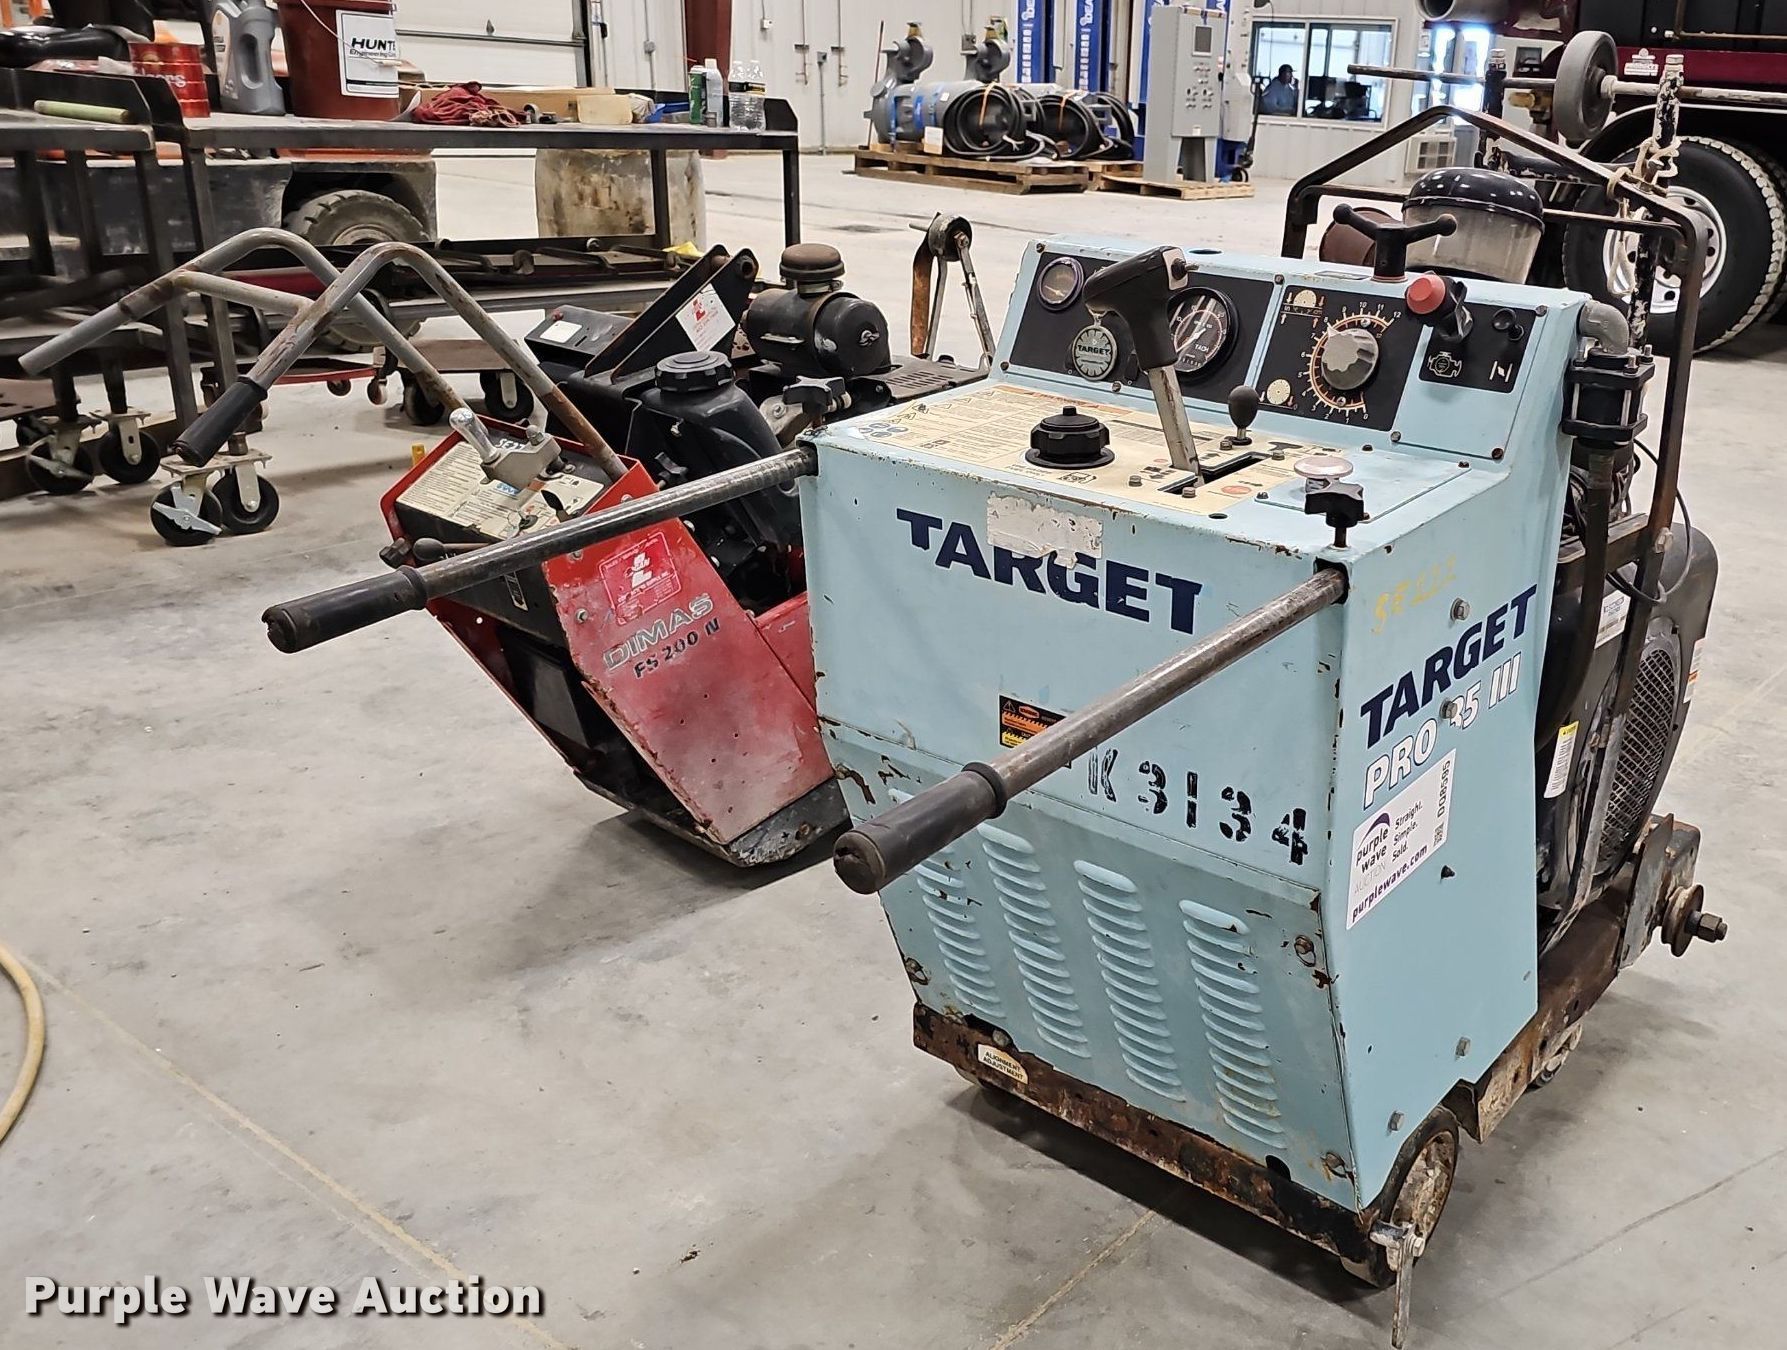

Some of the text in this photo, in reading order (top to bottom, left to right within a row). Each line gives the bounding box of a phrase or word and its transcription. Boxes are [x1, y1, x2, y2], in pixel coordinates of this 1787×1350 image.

[1078, 345, 1110, 355] TARGET
[896, 508, 1203, 635] TARGET
[603, 592, 713, 671] DIMAS
[634, 655, 659, 679] FS
[662, 631, 699, 662] 200
[1360, 584, 1537, 750] TARGET
[1363, 718, 1438, 811] PRO
[1489, 652, 1522, 710] III
[1393, 820, 1418, 847] Simple.
[1394, 800, 1423, 831] Straight.
[1355, 827, 1389, 868] purple
[1361, 844, 1387, 875] wave
[1391, 840, 1408, 863] Sold.
[1352, 844, 1428, 923] purplewave.com
[983, 1057, 1023, 1080] ADJUSTMENT
[985, 1051, 1021, 1072] ALIGNMENT
